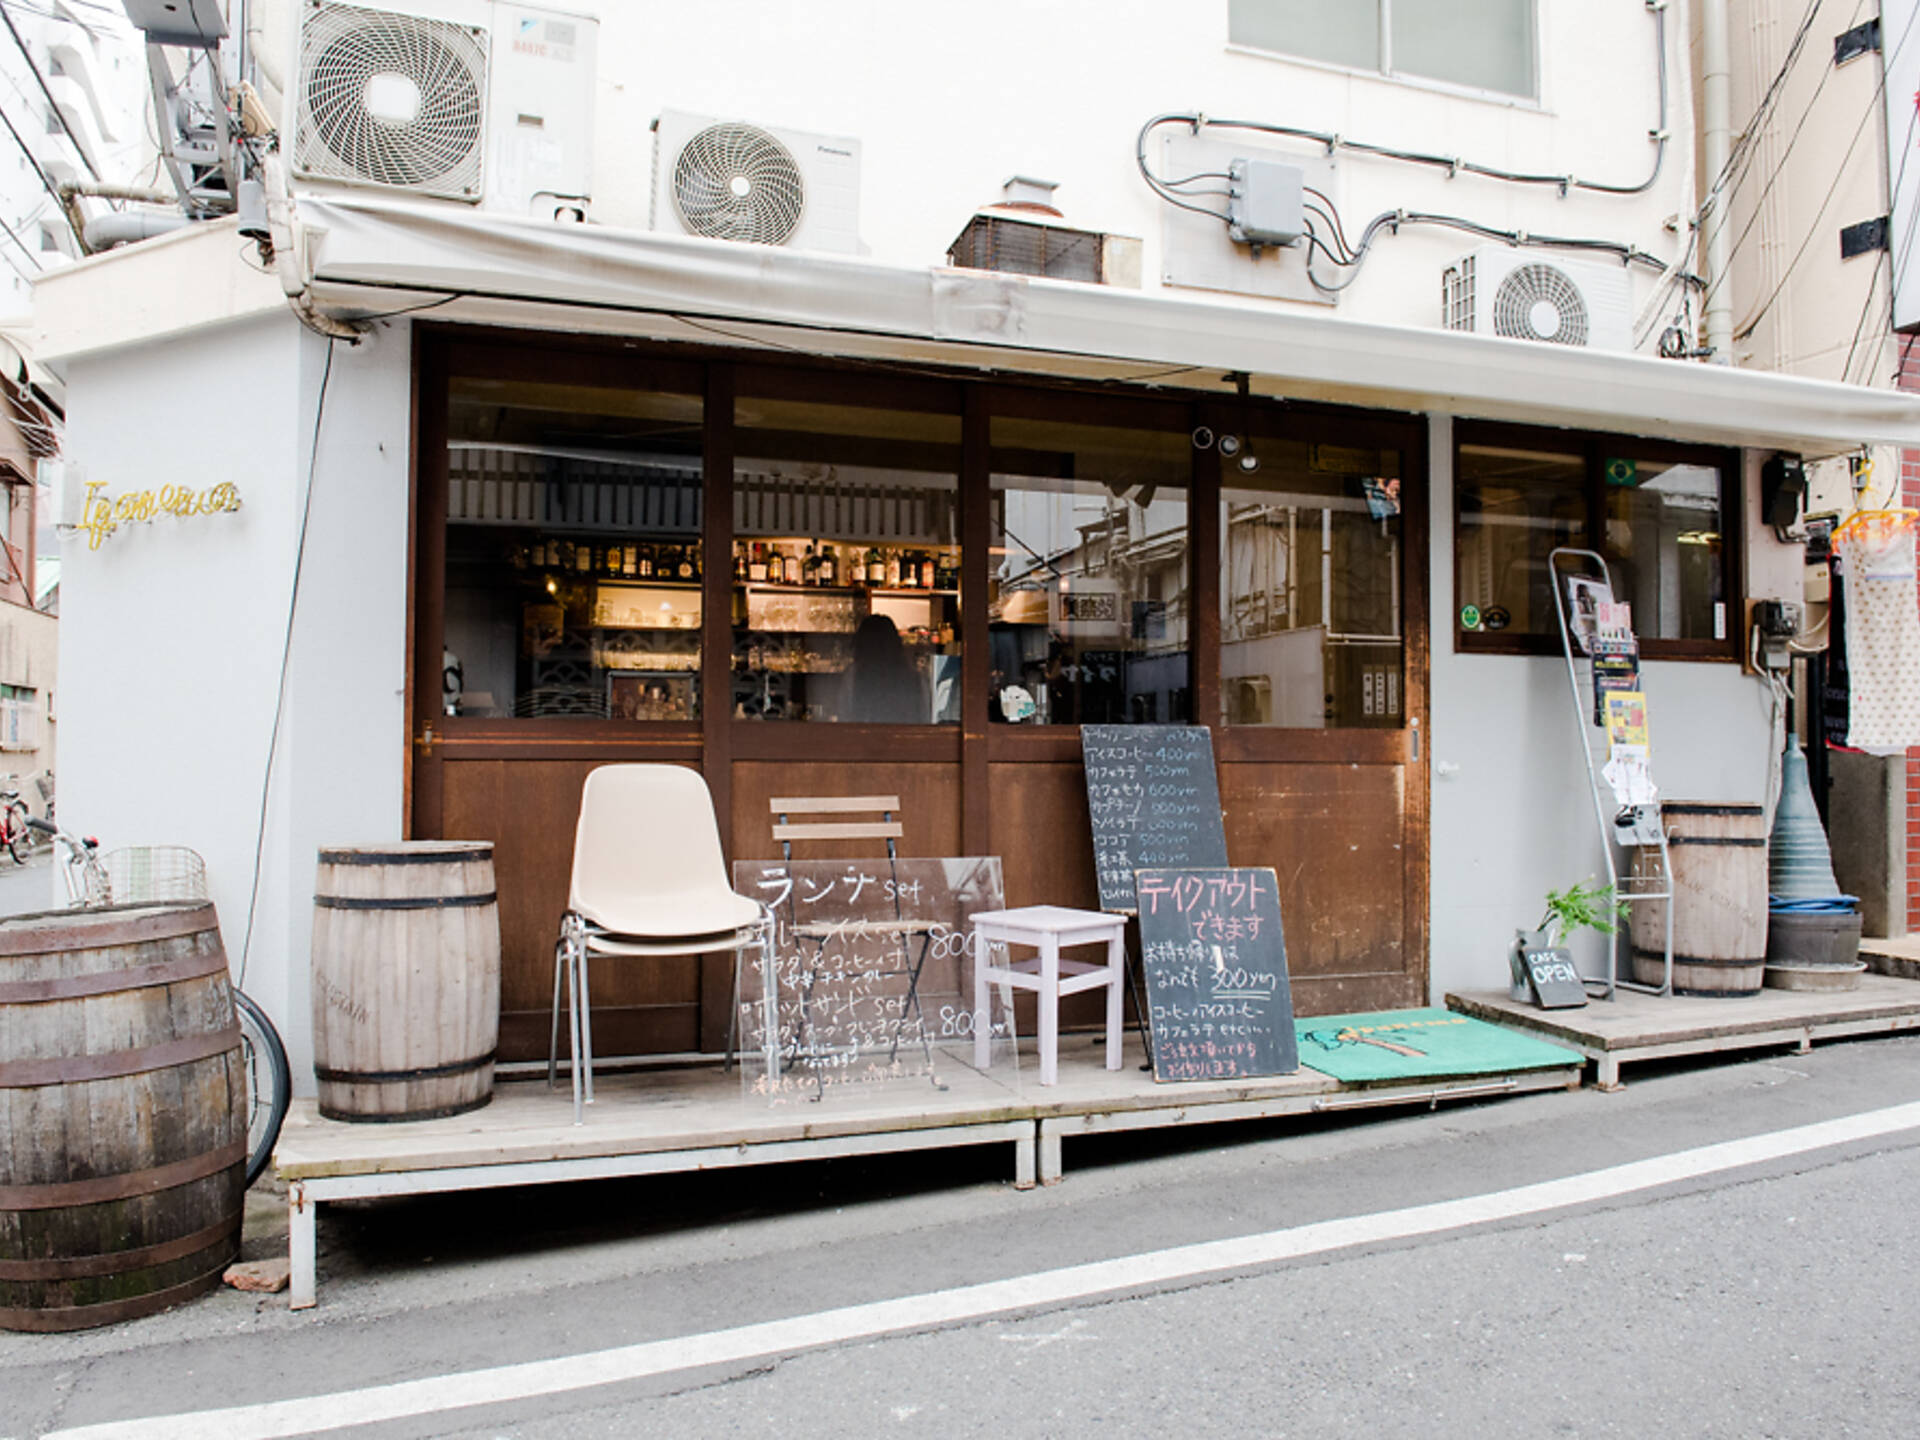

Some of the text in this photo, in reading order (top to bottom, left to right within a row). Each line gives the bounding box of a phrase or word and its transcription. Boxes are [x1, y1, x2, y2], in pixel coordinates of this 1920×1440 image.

[757, 866, 923, 909] ランチ set
[1140, 872, 1267, 915] テイクアウト
[1192, 909, 1265, 942] できます
[1532, 962, 1578, 985] OPEN
